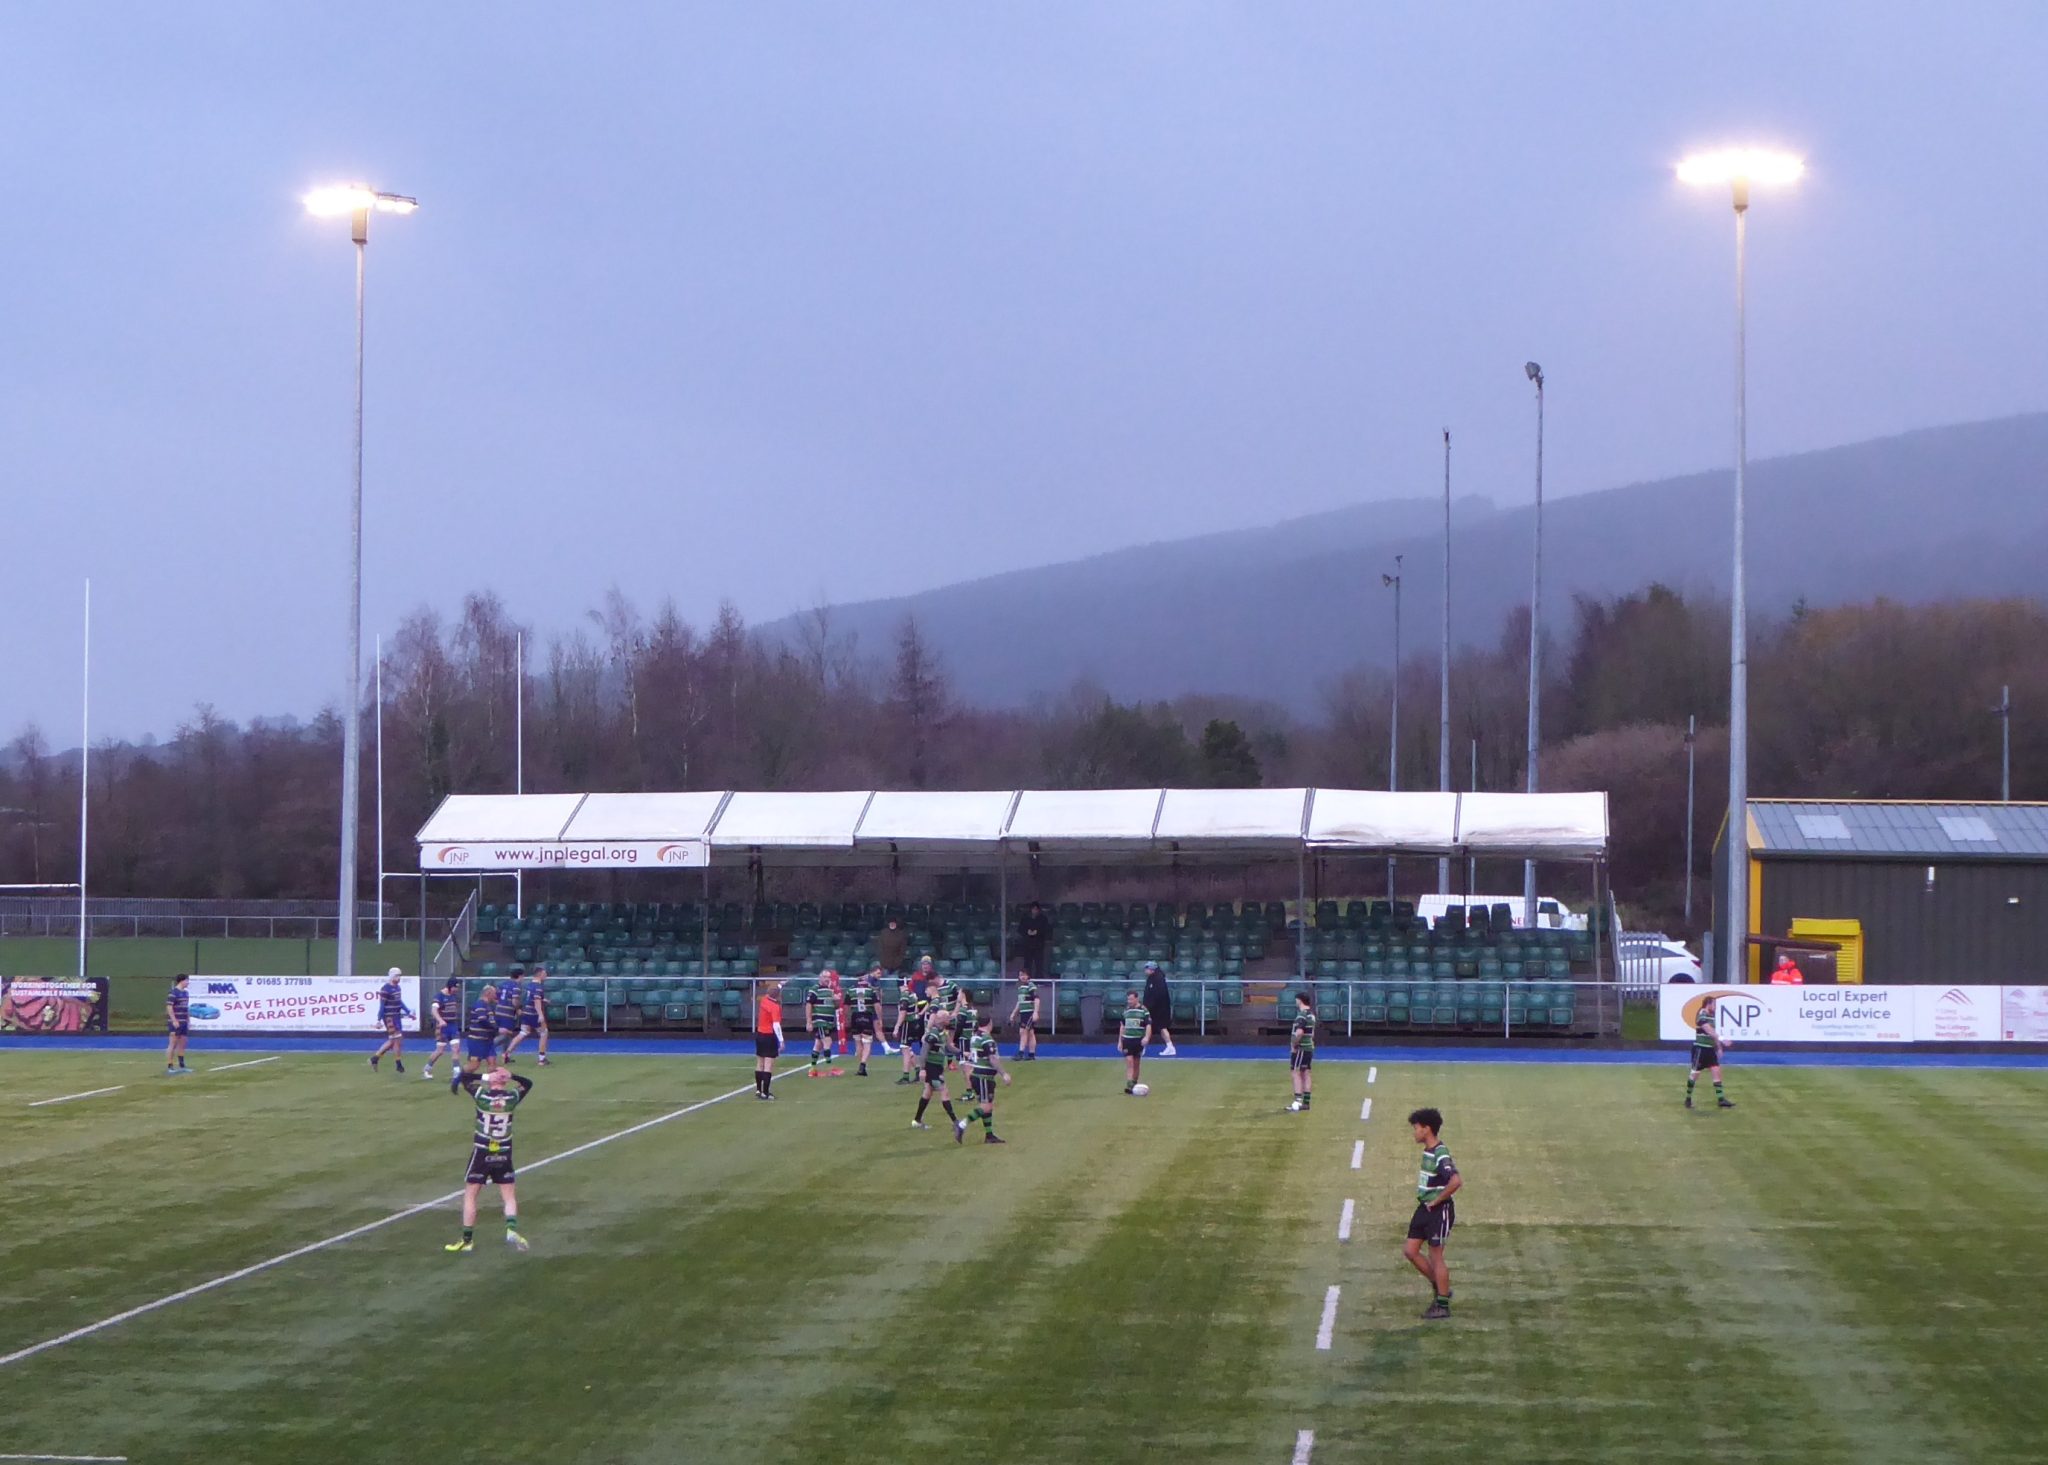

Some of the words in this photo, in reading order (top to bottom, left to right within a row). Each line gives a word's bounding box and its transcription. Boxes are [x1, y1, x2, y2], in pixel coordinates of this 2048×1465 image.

[449, 852, 470, 865] JNP
[494, 847, 637, 863] www.jnplegal.org
[669, 851, 689, 863] JNP
[256, 978, 281, 986] 01685
[223, 999, 262, 1011] SAVE
[266, 992, 359, 1007] THOUSANDS
[1803, 990, 1840, 1002] Local
[1845, 990, 1888, 1004] Expert
[245, 1007, 305, 1021] GARAGE
[311, 1003, 366, 1016] PRICES
[1720, 1004, 1761, 1028] NP
[1799, 1007, 1837, 1021] Legal
[1841, 1007, 1891, 1019] Advice
[482, 1113, 509, 1137] 13
